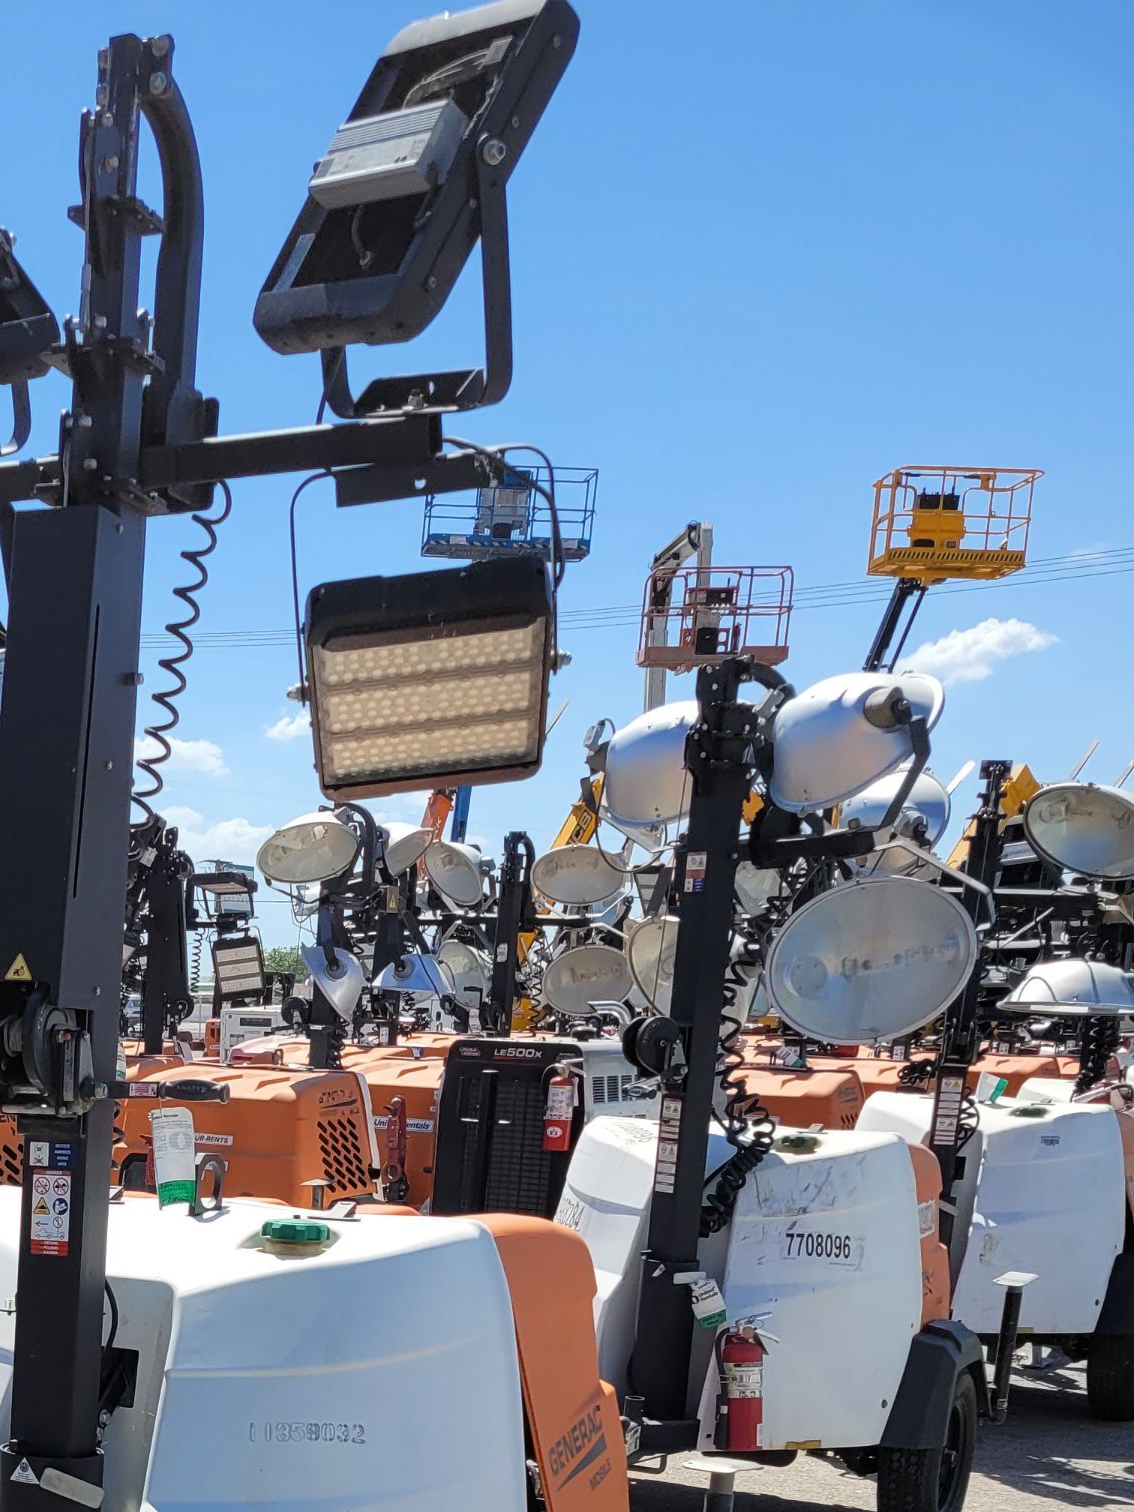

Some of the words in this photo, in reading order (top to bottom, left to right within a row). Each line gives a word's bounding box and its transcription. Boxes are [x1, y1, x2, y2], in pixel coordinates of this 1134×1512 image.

[407, 1121, 430, 1130] entals
[195, 1134, 229, 1144] UR-RENTS
[785, 1232, 851, 1259] 7708096
[249, 1422, 366, 1444] 11358032
[548, 1404, 602, 1477] GENERAC
